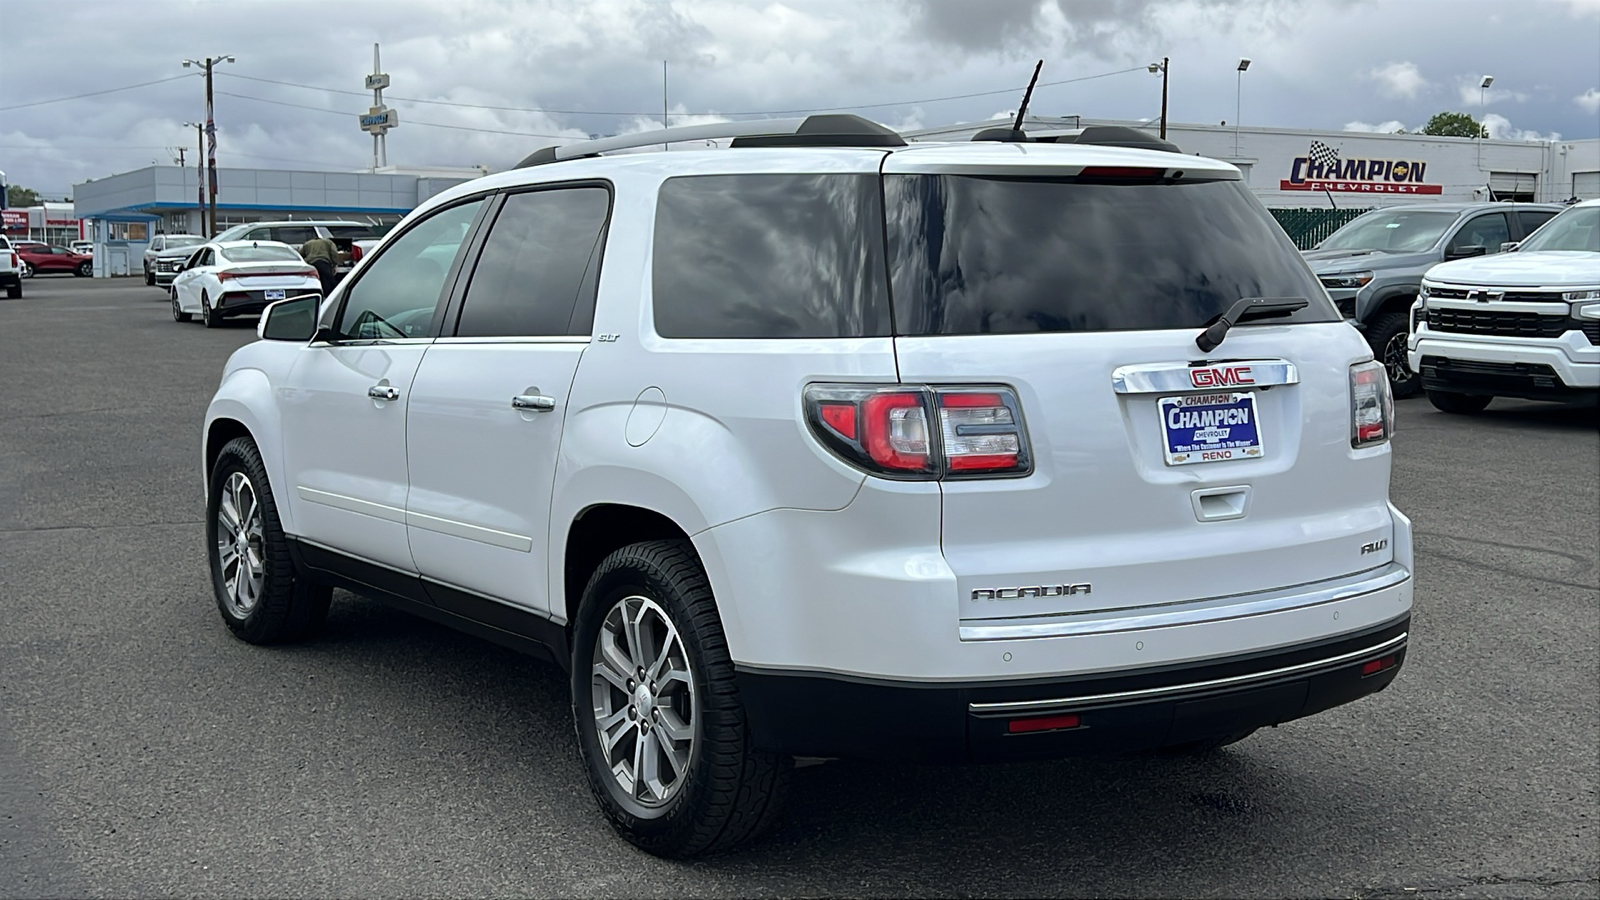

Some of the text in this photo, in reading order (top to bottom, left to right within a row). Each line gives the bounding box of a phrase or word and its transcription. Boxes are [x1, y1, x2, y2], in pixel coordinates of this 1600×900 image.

[1289, 157, 1427, 184] CHAMPION
[1311, 183, 1419, 192] CHEVROLET
[1190, 367, 1255, 387] GMC
[1185, 394, 1230, 406] CHAMPION
[1168, 407, 1249, 430] CHAMPION
[1195, 430, 1228, 439] CHEVROLET
[1202, 450, 1232, 461] RENO
[1361, 538, 1388, 555] AWD
[971, 583, 1092, 601] ACADIA
